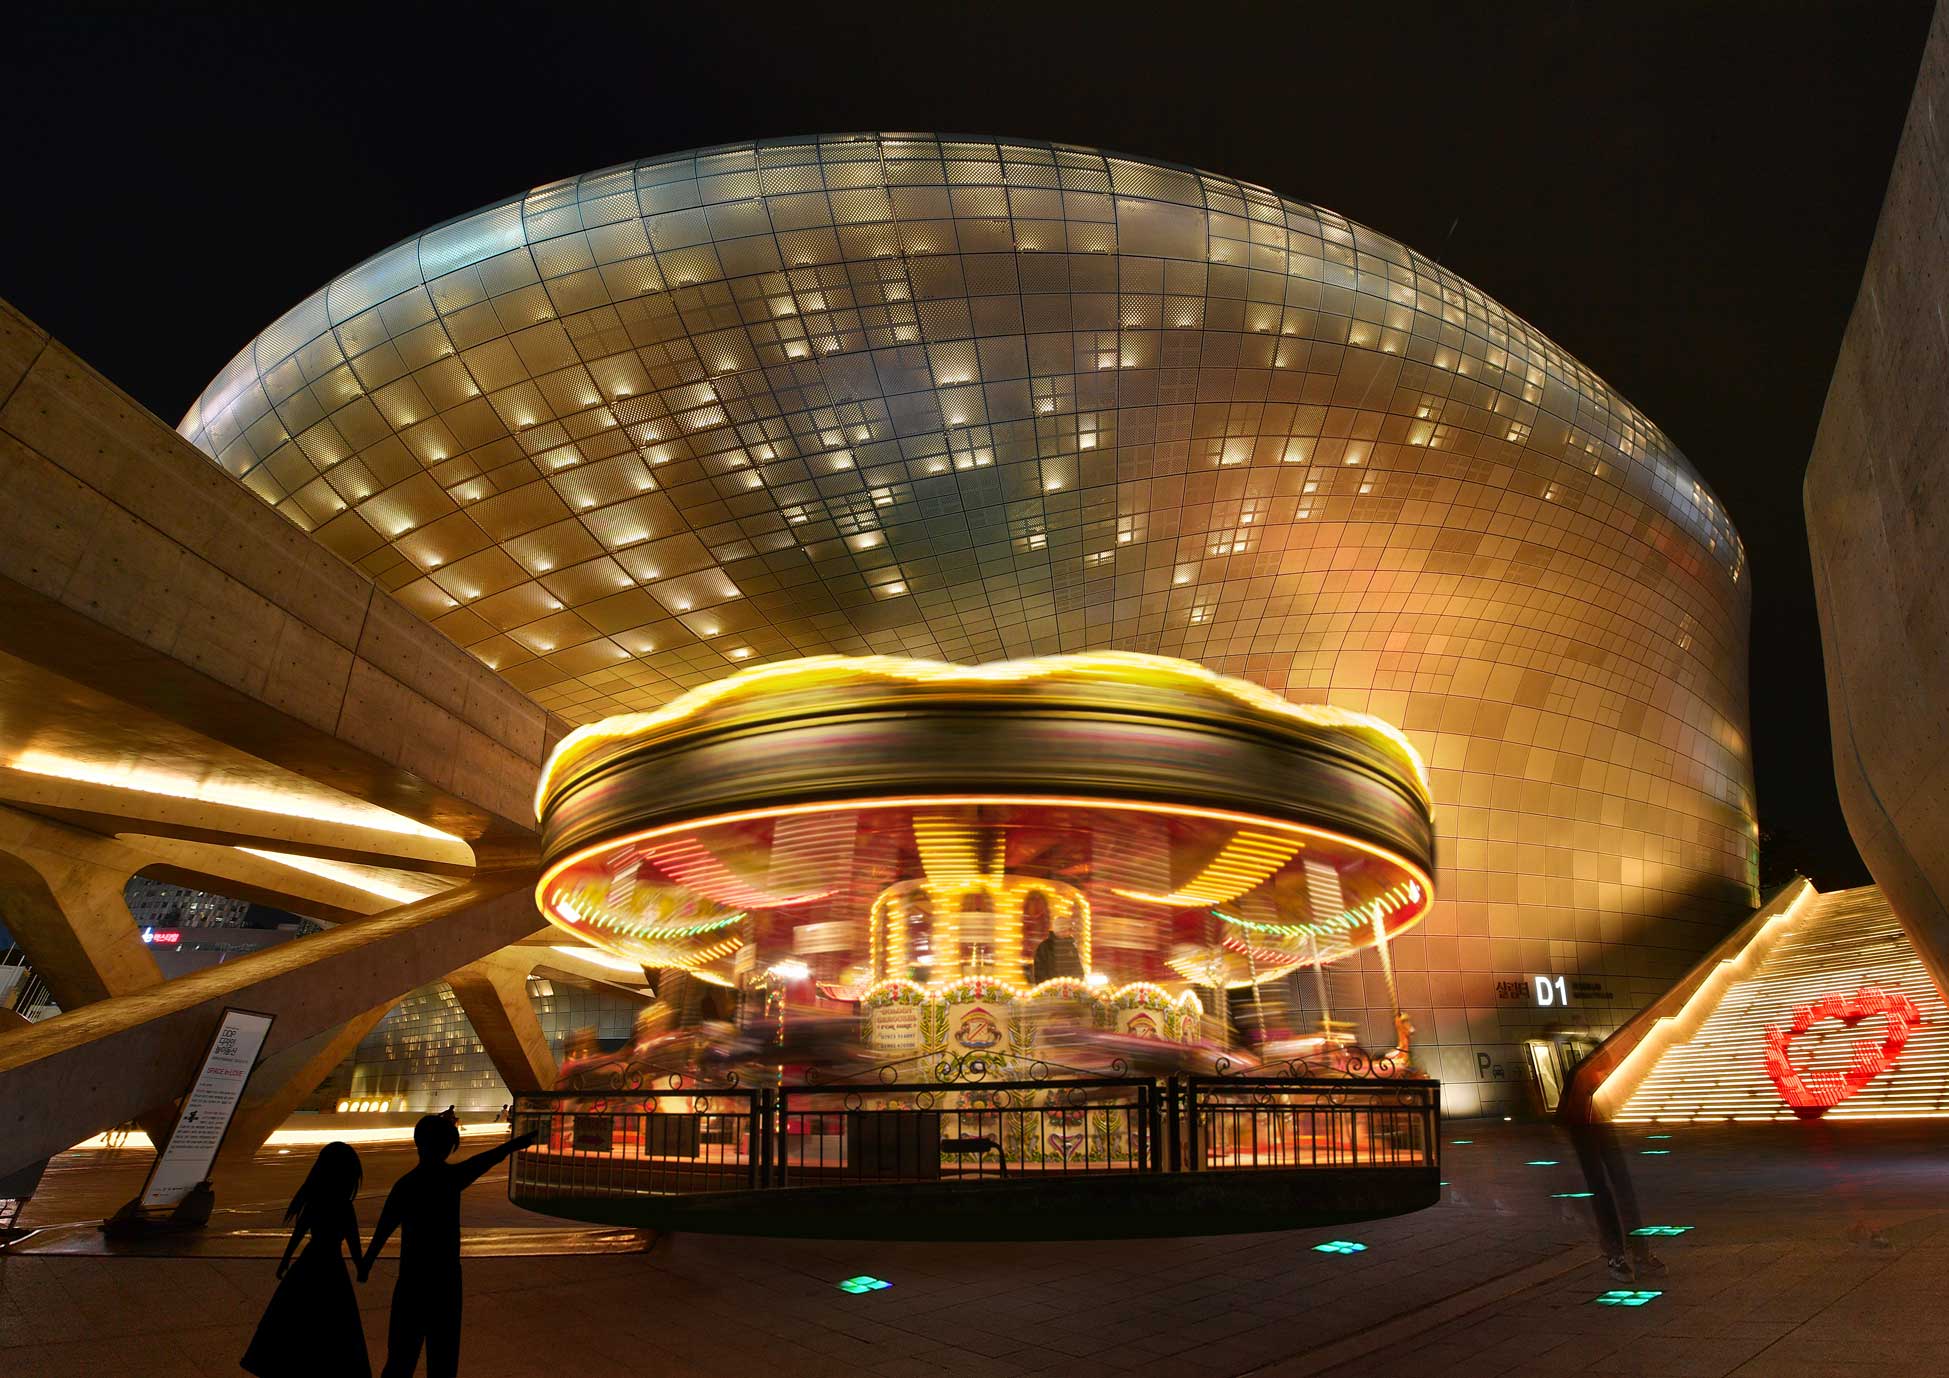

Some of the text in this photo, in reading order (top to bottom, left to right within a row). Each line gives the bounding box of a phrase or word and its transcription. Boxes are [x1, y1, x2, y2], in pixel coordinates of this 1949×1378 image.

[1496, 981, 1530, 1000] 살림터
[1534, 976, 1568, 1006] D1
[222, 1029, 237, 1038] DDP
[207, 1067, 224, 1075] SPACE
[230, 1069, 244, 1077] LOVE
[1477, 1053, 1491, 1078] P
